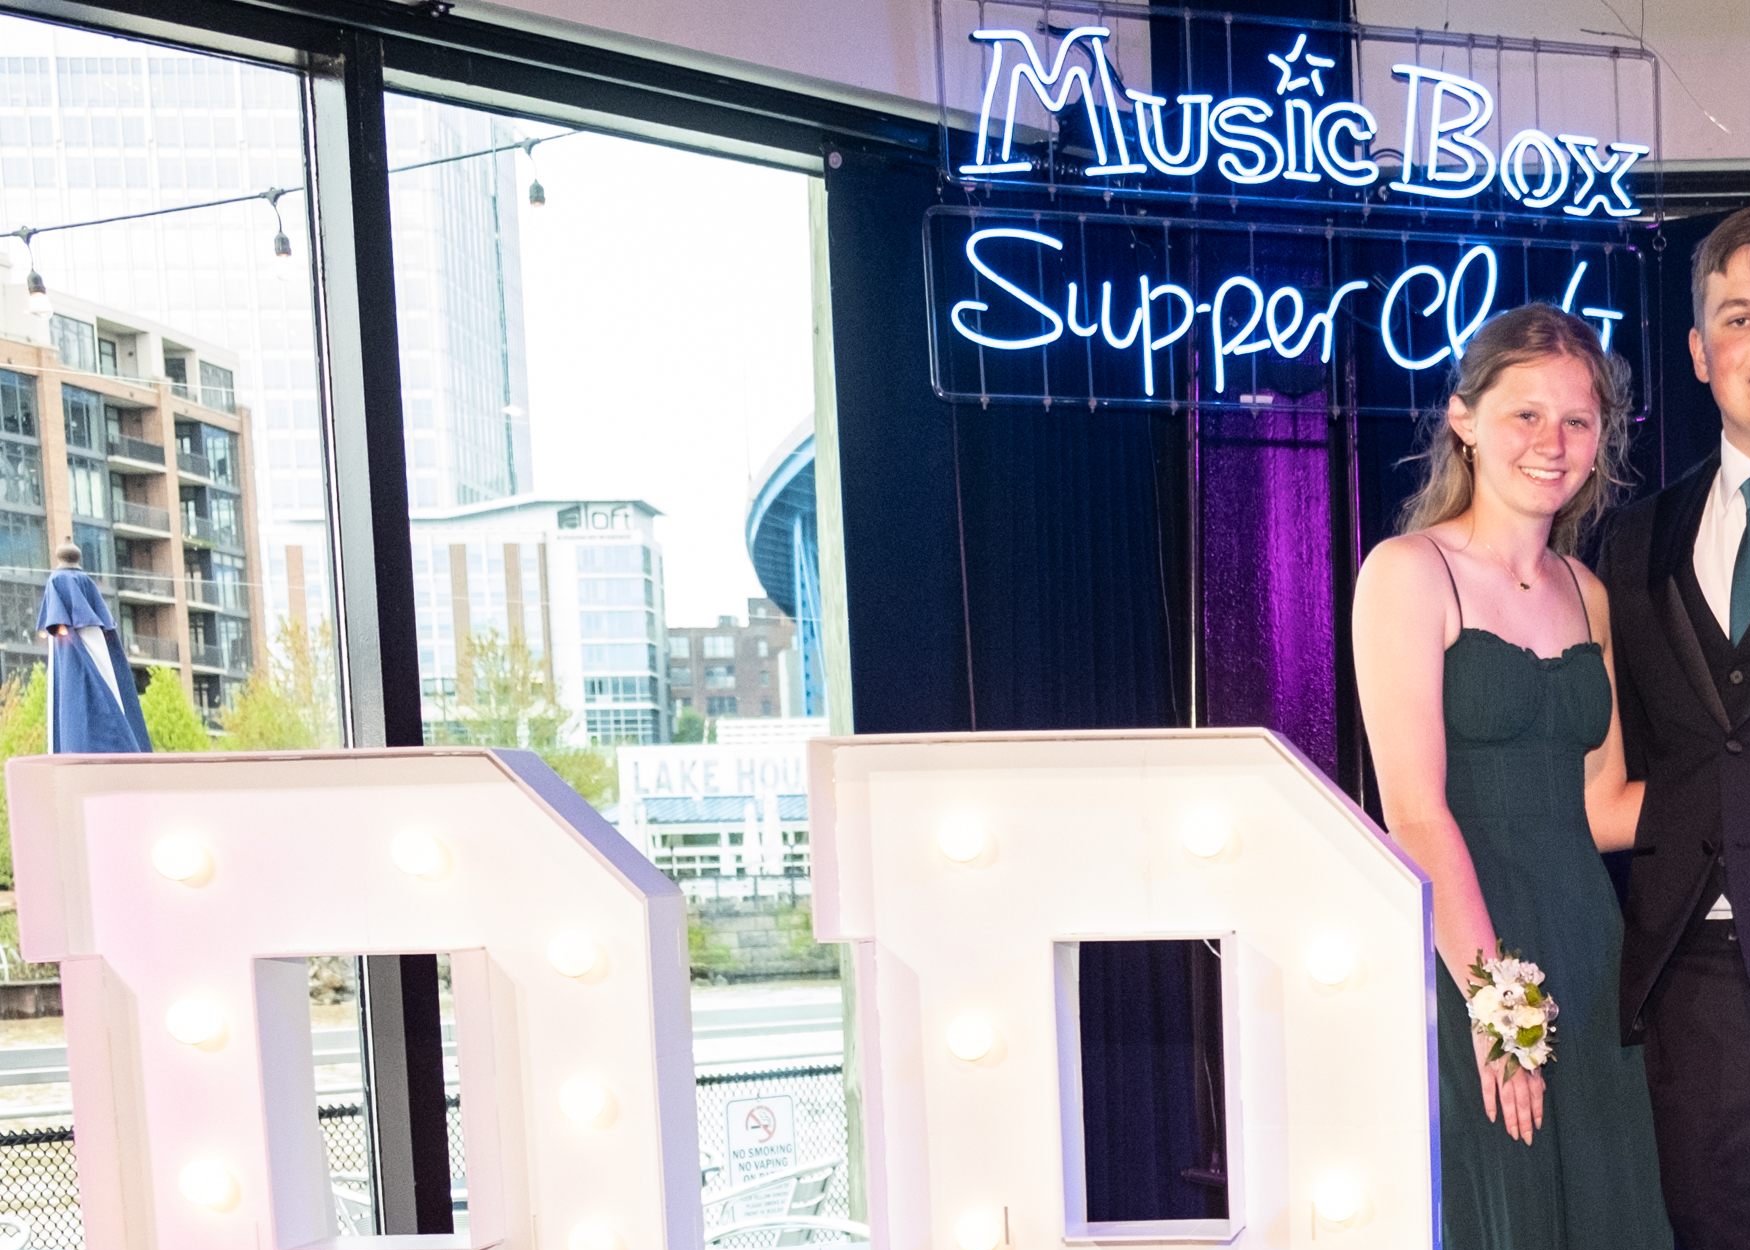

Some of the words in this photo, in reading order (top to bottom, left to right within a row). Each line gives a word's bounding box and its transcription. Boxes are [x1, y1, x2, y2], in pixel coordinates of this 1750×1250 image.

[951, 228, 1368, 396] Supper
[1380, 245, 1625, 370] Cl
[557, 501, 630, 529] aloft
[633, 758, 720, 795] LAKE
[736, 757, 807, 794] HOU
[732, 1149, 746, 1160] NO
[748, 1143, 793, 1159] SMOKING
[738, 1161, 752, 1172] NO
[753, 1157, 789, 1170] VAPING
